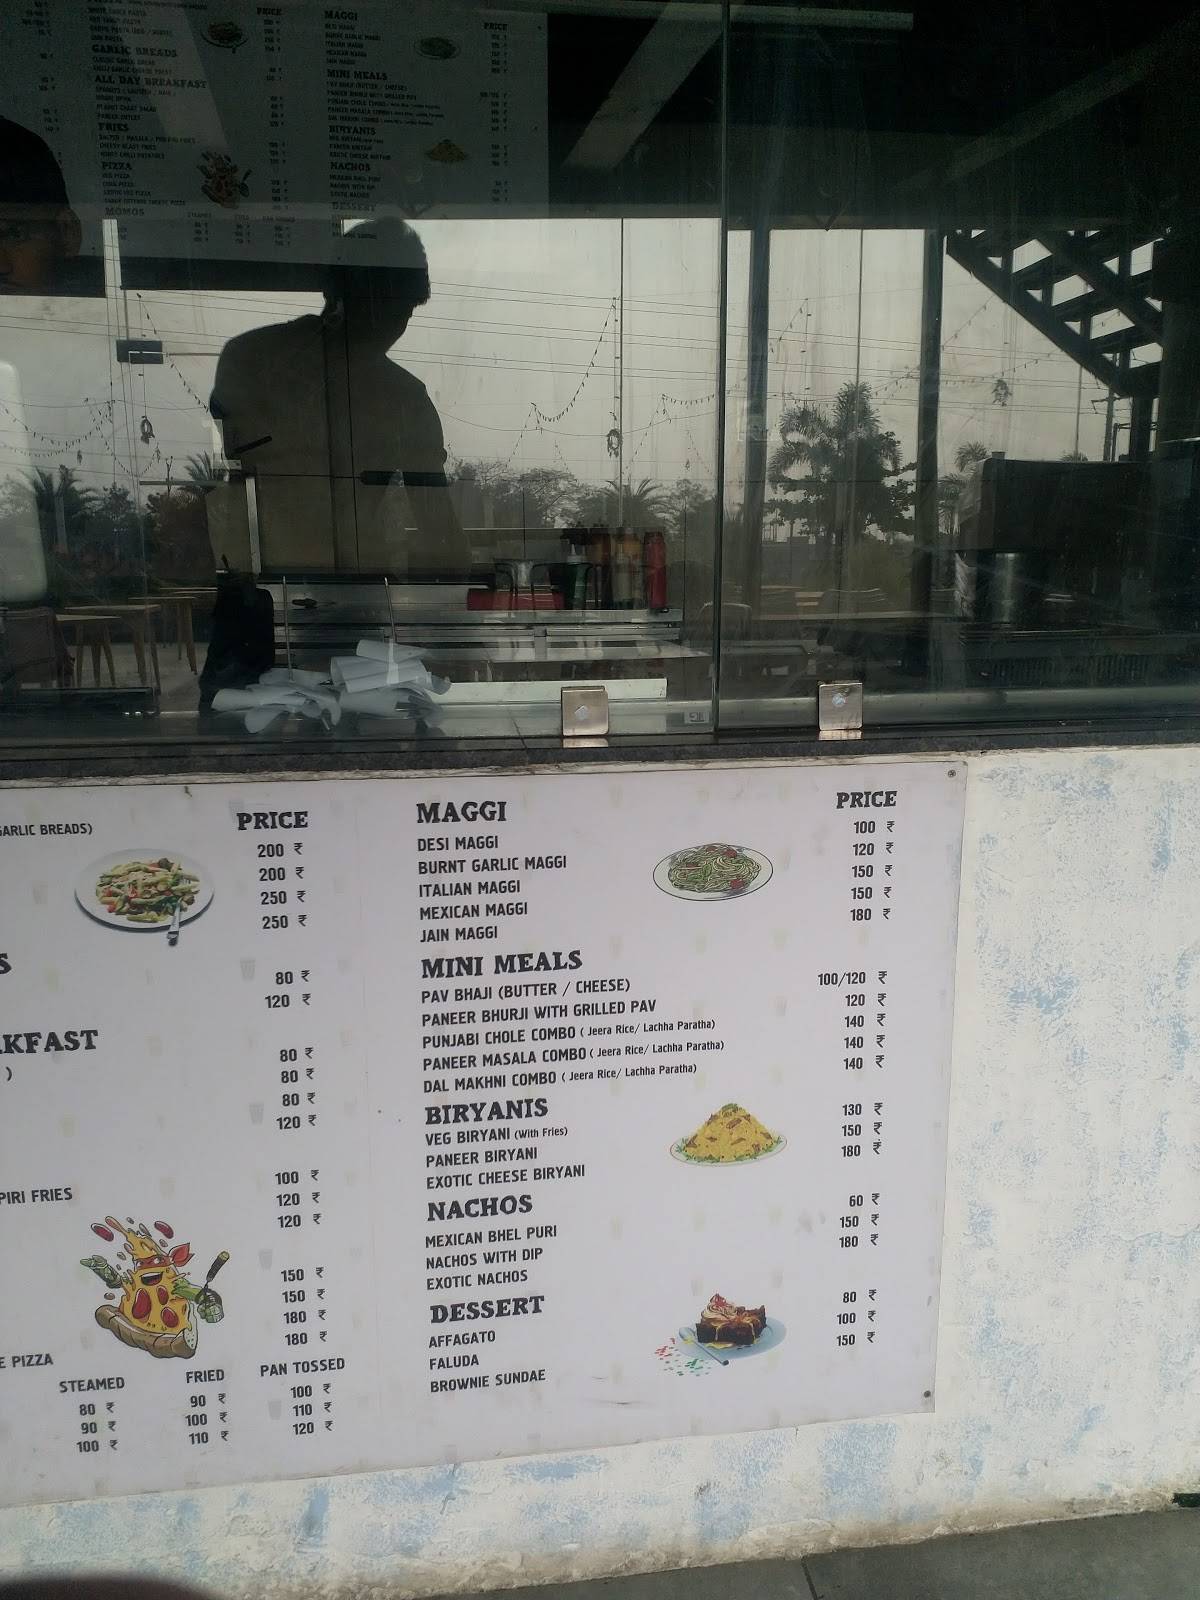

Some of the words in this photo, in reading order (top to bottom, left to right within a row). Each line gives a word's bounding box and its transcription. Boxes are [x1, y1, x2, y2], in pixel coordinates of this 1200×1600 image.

[837, 791, 897, 809] PRICE
[416, 801, 507, 823] MAGGI
[236, 811, 308, 830] PRICE
[40, 823, 92, 835] BREADS)
[854, 821, 875, 834] 100
[418, 838, 449, 851] DESI
[455, 836, 498, 850] MAGGI
[853, 843, 874, 856] 120
[257, 843, 284, 858] 200
[418, 860, 466, 874] BURNT
[472, 857, 519, 872] GARLIC
[525, 856, 566, 870] MAGGI
[852, 865, 873, 878] 150
[259, 867, 285, 881] 200
[419, 882, 472, 897] ITALIAN
[478, 880, 520, 894] MAGGI
[851, 887, 872, 899] 150
[261, 891, 287, 905] 250
[420, 905, 479, 920] MEXICAN
[486, 902, 527, 916] MAGGI
[850, 908, 871, 921] 180
[262, 915, 288, 929] 250
[420, 929, 449, 942] JAIN
[456, 926, 497, 941] MAGGI
[421, 957, 483, 979] MINI
[494, 950, 582, 974] MEALS
[276, 971, 293, 985] 80
[818, 972, 866, 987] 100/120
[422, 990, 449, 1003] PAV
[455, 987, 492, 1001] BHAJI
[499, 983, 557, 1000] (BUTTER
[576, 979, 630, 993] CHEESE)
[265, 995, 290, 1008] 120
[845, 994, 865, 1006] 120
[422, 1011, 476, 1027] PANEER
[482, 1007, 528, 1022] BHURJI
[534, 1005, 567, 1019] WITH
[574, 1001, 625, 1016] GRILLED
[631, 1000, 656, 1013] PAV
[845, 1015, 864, 1028] 140
[423, 1033, 479, 1048] PUNJABI
[485, 1029, 525, 1044] CHOLE
[532, 1026, 575, 1041] COMBO
[616, 1024, 640, 1034] Rice/
[644, 1022, 673, 1032] Lachha
[678, 1019, 715, 1030] Paratha)
[844, 1036, 863, 1048] 140
[280, 1049, 297, 1062] 80
[423, 1055, 477, 1071] PANEER
[483, 1051, 536, 1067] MASALA
[543, 1048, 586, 1062] COMBO
[625, 1044, 649, 1055] Rice/
[653, 1043, 682, 1053] Lachha
[687, 1041, 724, 1051] Paratha)
[844, 1057, 863, 1070] 140
[281, 1070, 298, 1083] 80
[281, 1070, 298, 1083] 80
[424, 1079, 449, 1093] DAL
[455, 1075, 506, 1091] MAKHNI
[512, 1071, 556, 1086] COMBO
[598, 1068, 621, 1079] Rice/
[626, 1066, 655, 1076] Lachha
[659, 1064, 696, 1074] Paratha)
[282, 1093, 299, 1106] 80
[425, 1098, 548, 1125] BIRYANIS
[842, 1104, 862, 1116] 130
[276, 1116, 300, 1130] 120
[425, 1132, 451, 1146] VEG
[457, 1128, 510, 1143] BIRYANI
[515, 1129, 538, 1140] (With
[543, 1127, 568, 1137] Fries)
[842, 1124, 861, 1136] 150
[426, 1152, 479, 1168] PANEER
[485, 1147, 537, 1163] BIRYANI
[841, 1145, 860, 1157] 180
[275, 1171, 299, 1185] 100
[427, 1174, 472, 1189] EXOTIC
[479, 1169, 527, 1185] CHEESE
[534, 1165, 584, 1180] BIRYANI
[0, 1191, 25, 1204] PIRI
[31, 1187, 72, 1202] FRIES
[276, 1193, 300, 1206] 120
[849, 1195, 863, 1207] 60
[427, 1195, 532, 1221] NACHOS
[278, 1215, 301, 1228] 120
[840, 1216, 859, 1228] 150
[426, 1232, 482, 1248] MEXICAN
[488, 1228, 521, 1242] BHEL
[527, 1225, 556, 1239] PURI
[839, 1236, 858, 1248] 180
[427, 1253, 477, 1269] NACHOS
[483, 1250, 516, 1264] WITH
[523, 1248, 543, 1260] DIP
[281, 1269, 304, 1282] 150
[427, 1275, 472, 1290] EXOTIC
[478, 1270, 527, 1285] NACHOS
[282, 1290, 305, 1303] 150
[843, 1292, 856, 1303] 80
[430, 1295, 544, 1323] DESSERT
[284, 1311, 306, 1324] 180
[837, 1313, 856, 1324] 100
[285, 1333, 307, 1346] 180
[429, 1330, 495, 1348] AFFAGATO
[837, 1334, 855, 1346] 150
[12, 1353, 53, 1368] PIZZA
[430, 1354, 479, 1370] FALUDA
[260, 1363, 287, 1377] PAN
[293, 1358, 345, 1373] TOSSED
[186, 1369, 224, 1383] FRIED
[431, 1376, 489, 1392] BROWNIE
[495, 1369, 545, 1386] SUNDAE
[59, 1377, 125, 1393] STEAMED
[291, 1385, 312, 1398] 100
[190, 1395, 206, 1407] 90
[79, 1404, 95, 1416] 80
[293, 1404, 312, 1416] 110
[185, 1414, 207, 1426] 100
[81, 1422, 97, 1434] 90
[293, 1422, 314, 1435] 120
[189, 1432, 208, 1445] 110
[77, 1440, 99, 1452] 100
